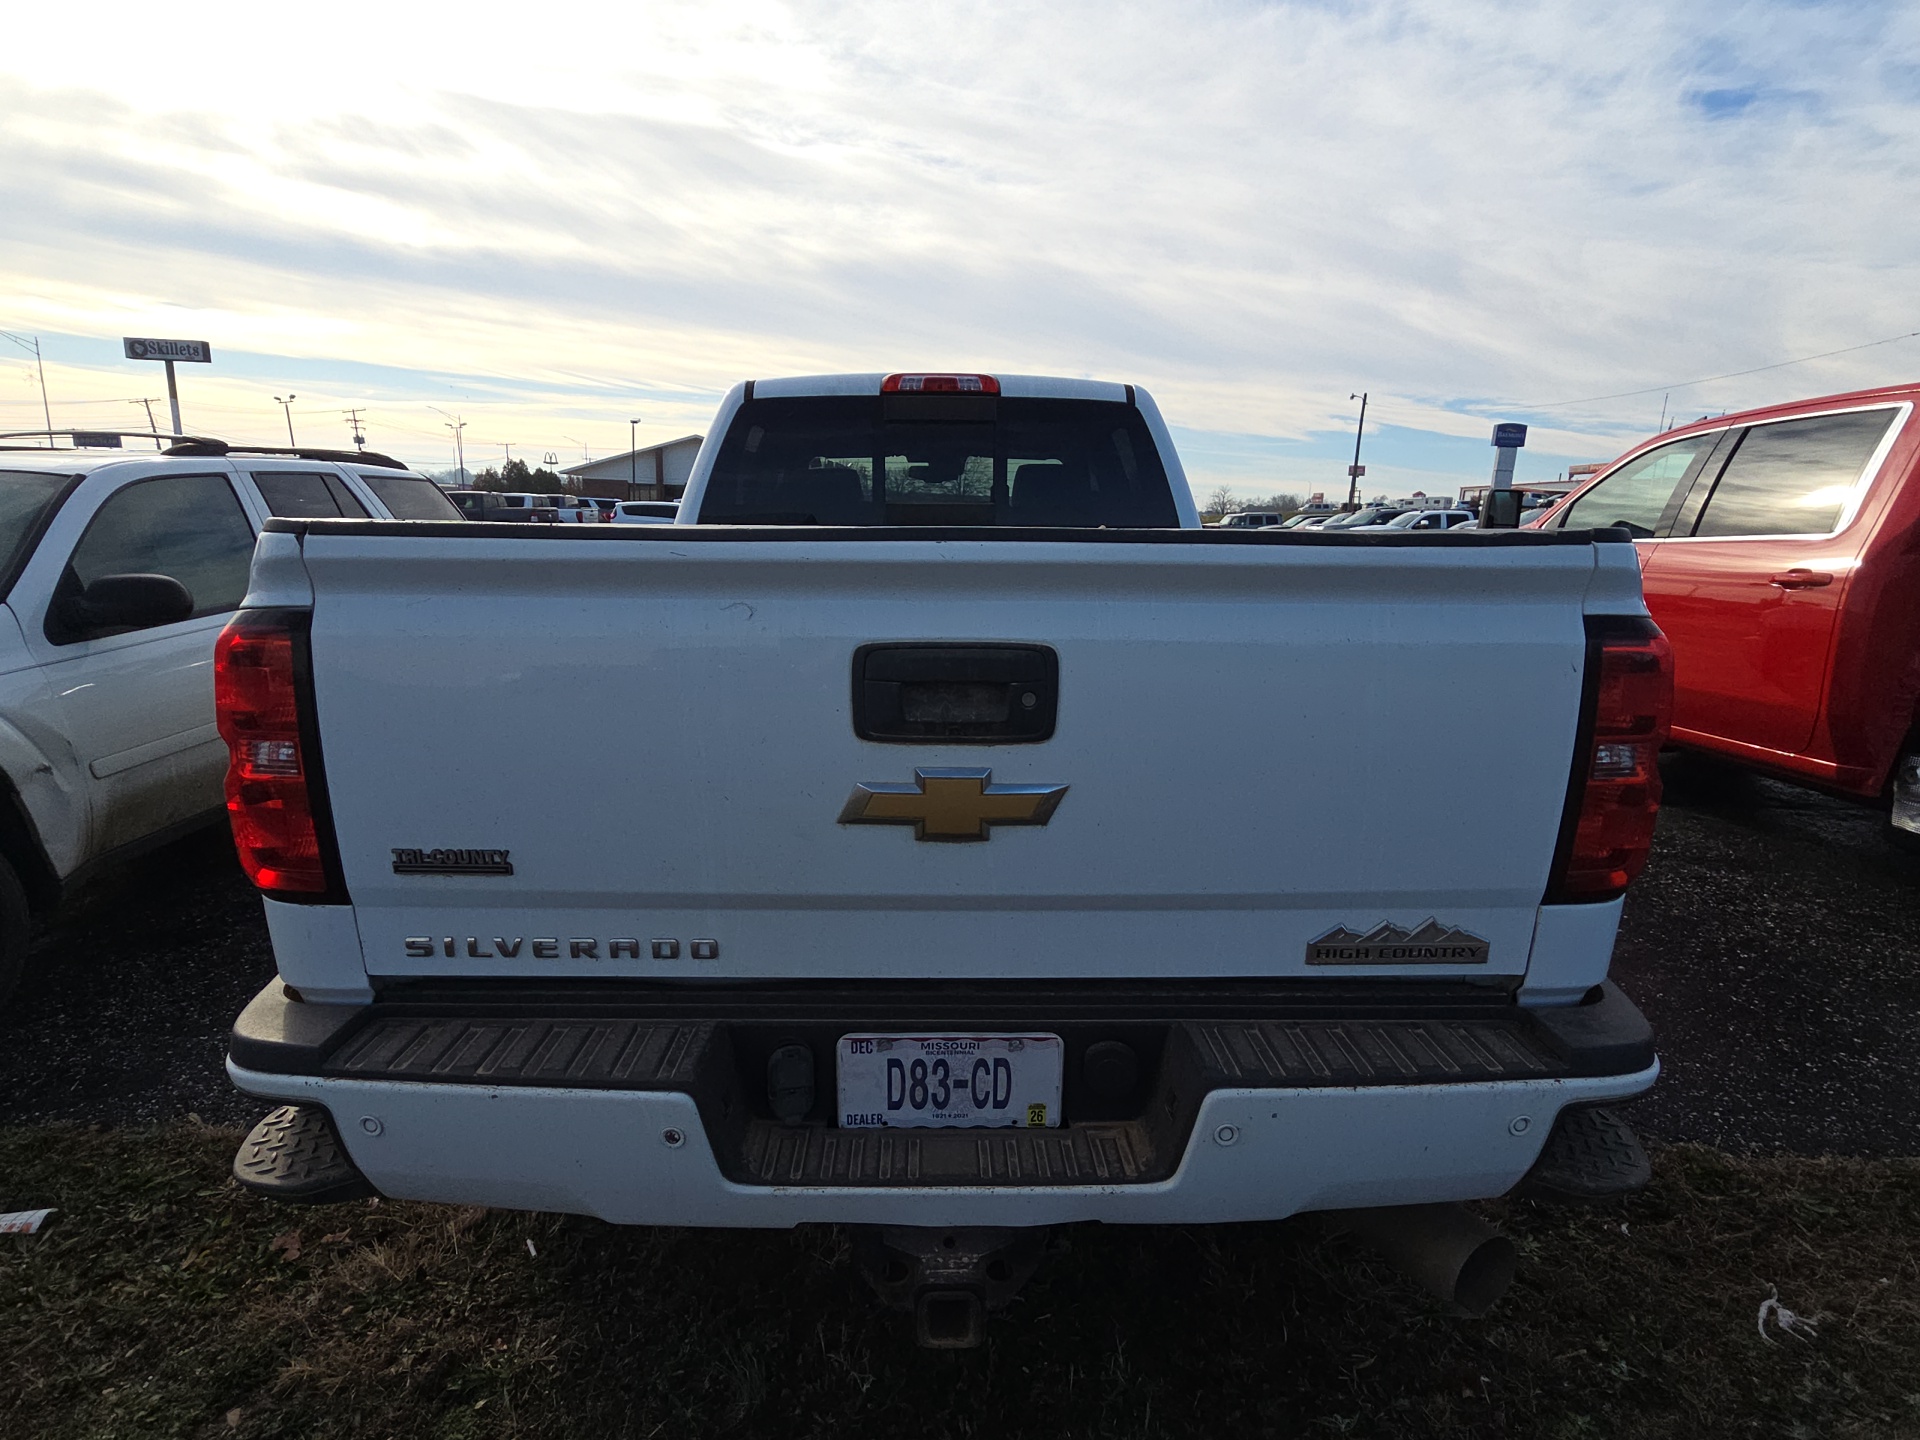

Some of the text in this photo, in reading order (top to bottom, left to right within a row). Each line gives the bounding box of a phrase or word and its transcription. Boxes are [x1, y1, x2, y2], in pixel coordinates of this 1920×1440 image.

[148, 340, 200, 357] Skillets
[391, 848, 510, 865] TRI-COUNTY
[405, 936, 720, 960] SILVERADO
[1316, 946, 1482, 959] HIGH COUNTRY
[850, 1040, 873, 1054] DEC
[920, 1042, 980, 1051] MISSOURI
[887, 1057, 1012, 1111] D83-CD
[846, 1113, 883, 1126] DEALER
[1030, 1110, 1044, 1123] 26
